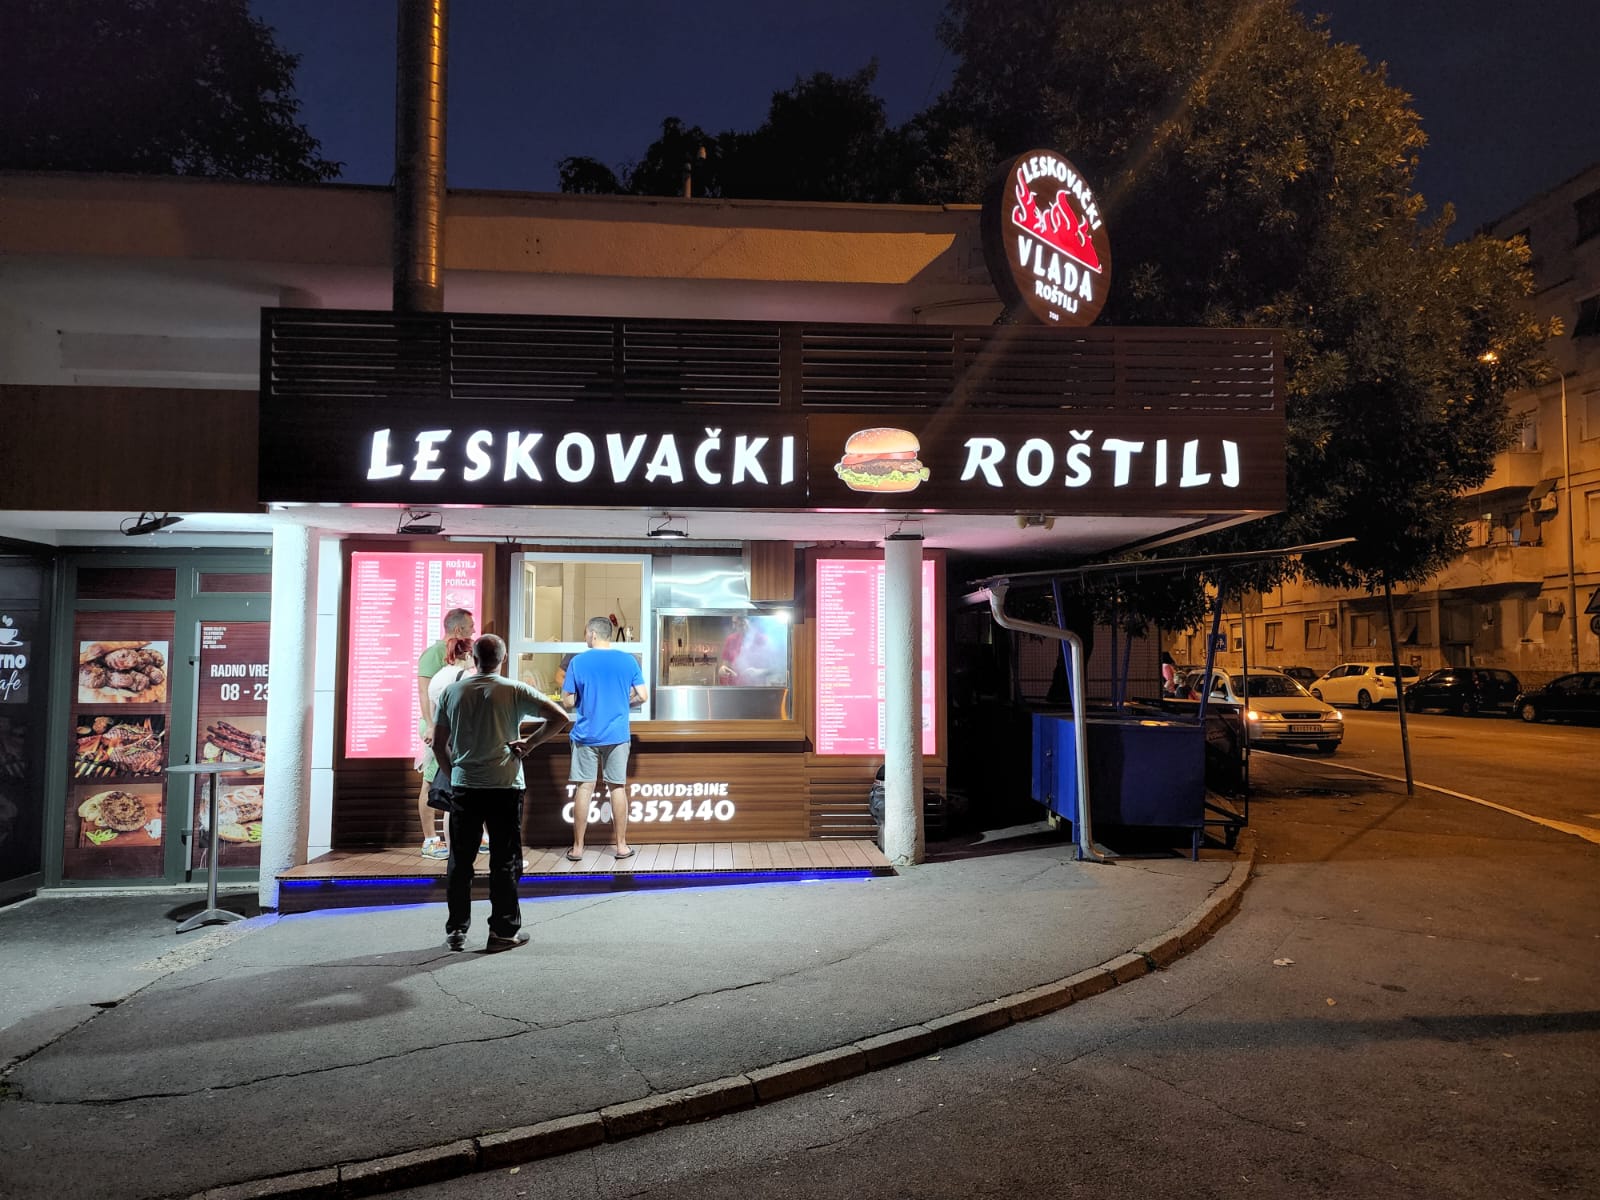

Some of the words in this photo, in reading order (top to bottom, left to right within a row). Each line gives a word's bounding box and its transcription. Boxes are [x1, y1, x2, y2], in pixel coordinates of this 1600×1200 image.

[1022, 156, 1102, 231] LESKOVAČKI
[1018, 235, 1092, 302] VLADA
[1035, 279, 1078, 314] ROŠTILJ
[367, 428, 795, 485] LESKOVAČKI
[960, 430, 1240, 487] ROŠTILJ
[446, 559, 476, 569] ROŠTILJ
[210, 664, 246, 677] RADNO
[221, 683, 240, 701] 08
